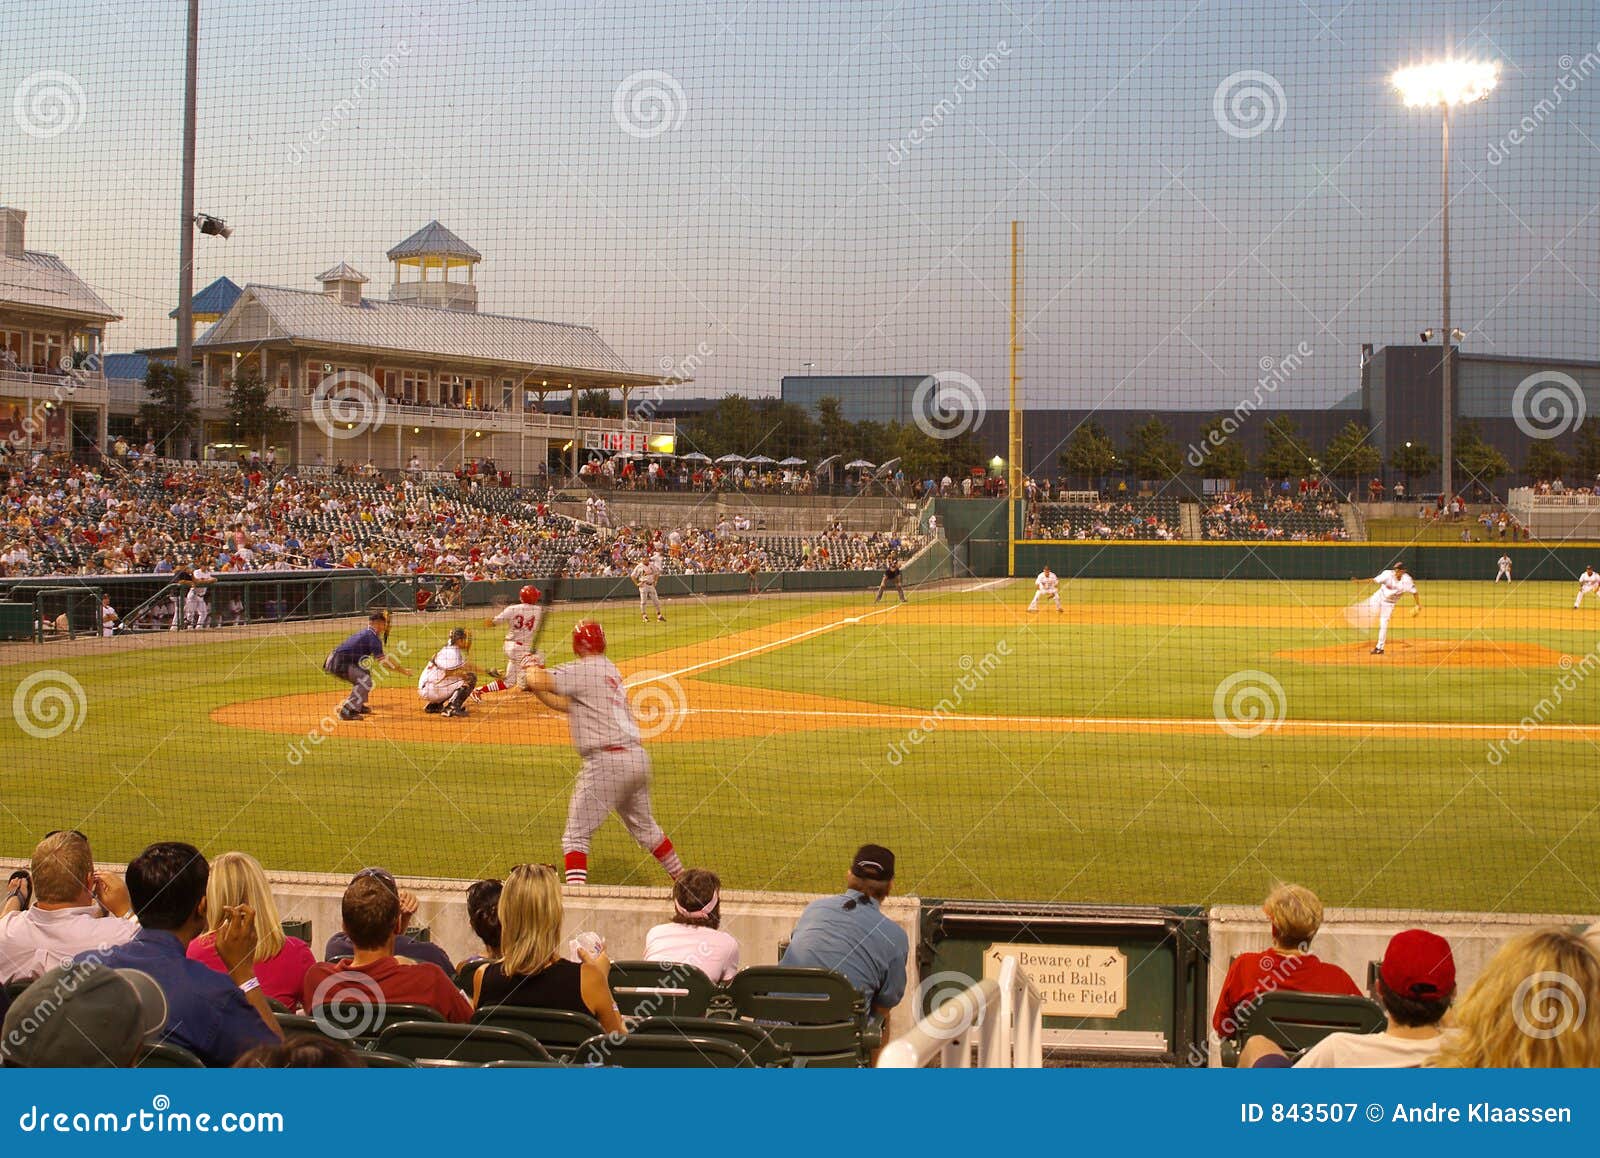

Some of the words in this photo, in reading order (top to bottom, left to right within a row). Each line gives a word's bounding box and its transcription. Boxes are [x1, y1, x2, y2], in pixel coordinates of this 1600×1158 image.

[514, 614, 536, 631] 34
[1020, 952, 1072, 967] Beware
[1077, 955, 1091, 967] of
[1039, 971, 1065, 984] and
[1071, 972, 1106, 985] Balls
[1052, 989, 1075, 1002] the
[1081, 990, 1117, 1003] Field
